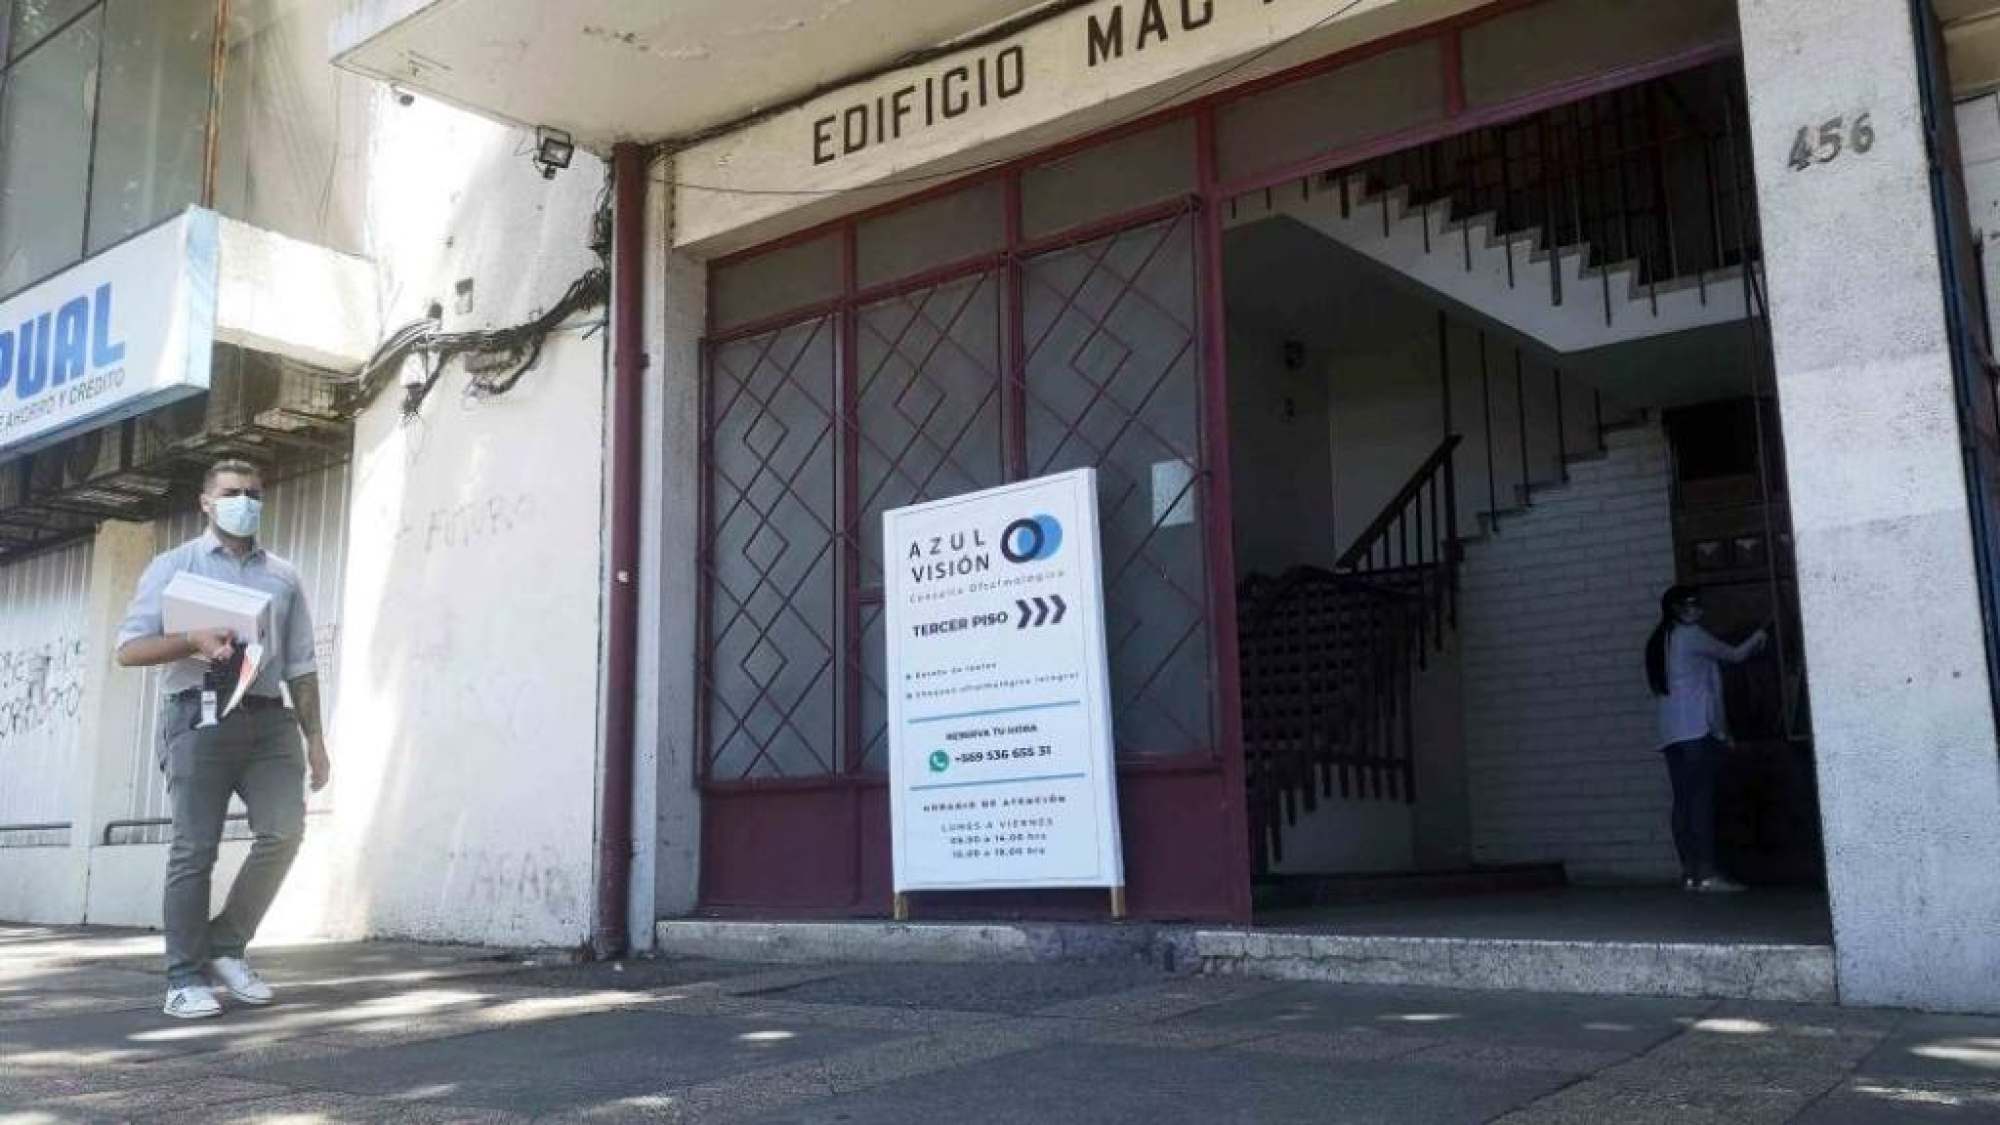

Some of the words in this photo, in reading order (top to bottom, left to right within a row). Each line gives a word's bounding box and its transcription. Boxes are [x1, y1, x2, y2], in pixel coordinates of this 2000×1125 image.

[814, 45, 1024, 166] EDIFICIO
[1788, 112, 1874, 172] 456
[910, 528, 985, 559] AZUL
[911, 552, 989, 583] VISIÓN
[912, 618, 968, 638] TERCER
[972, 610, 1009, 628] PISO
